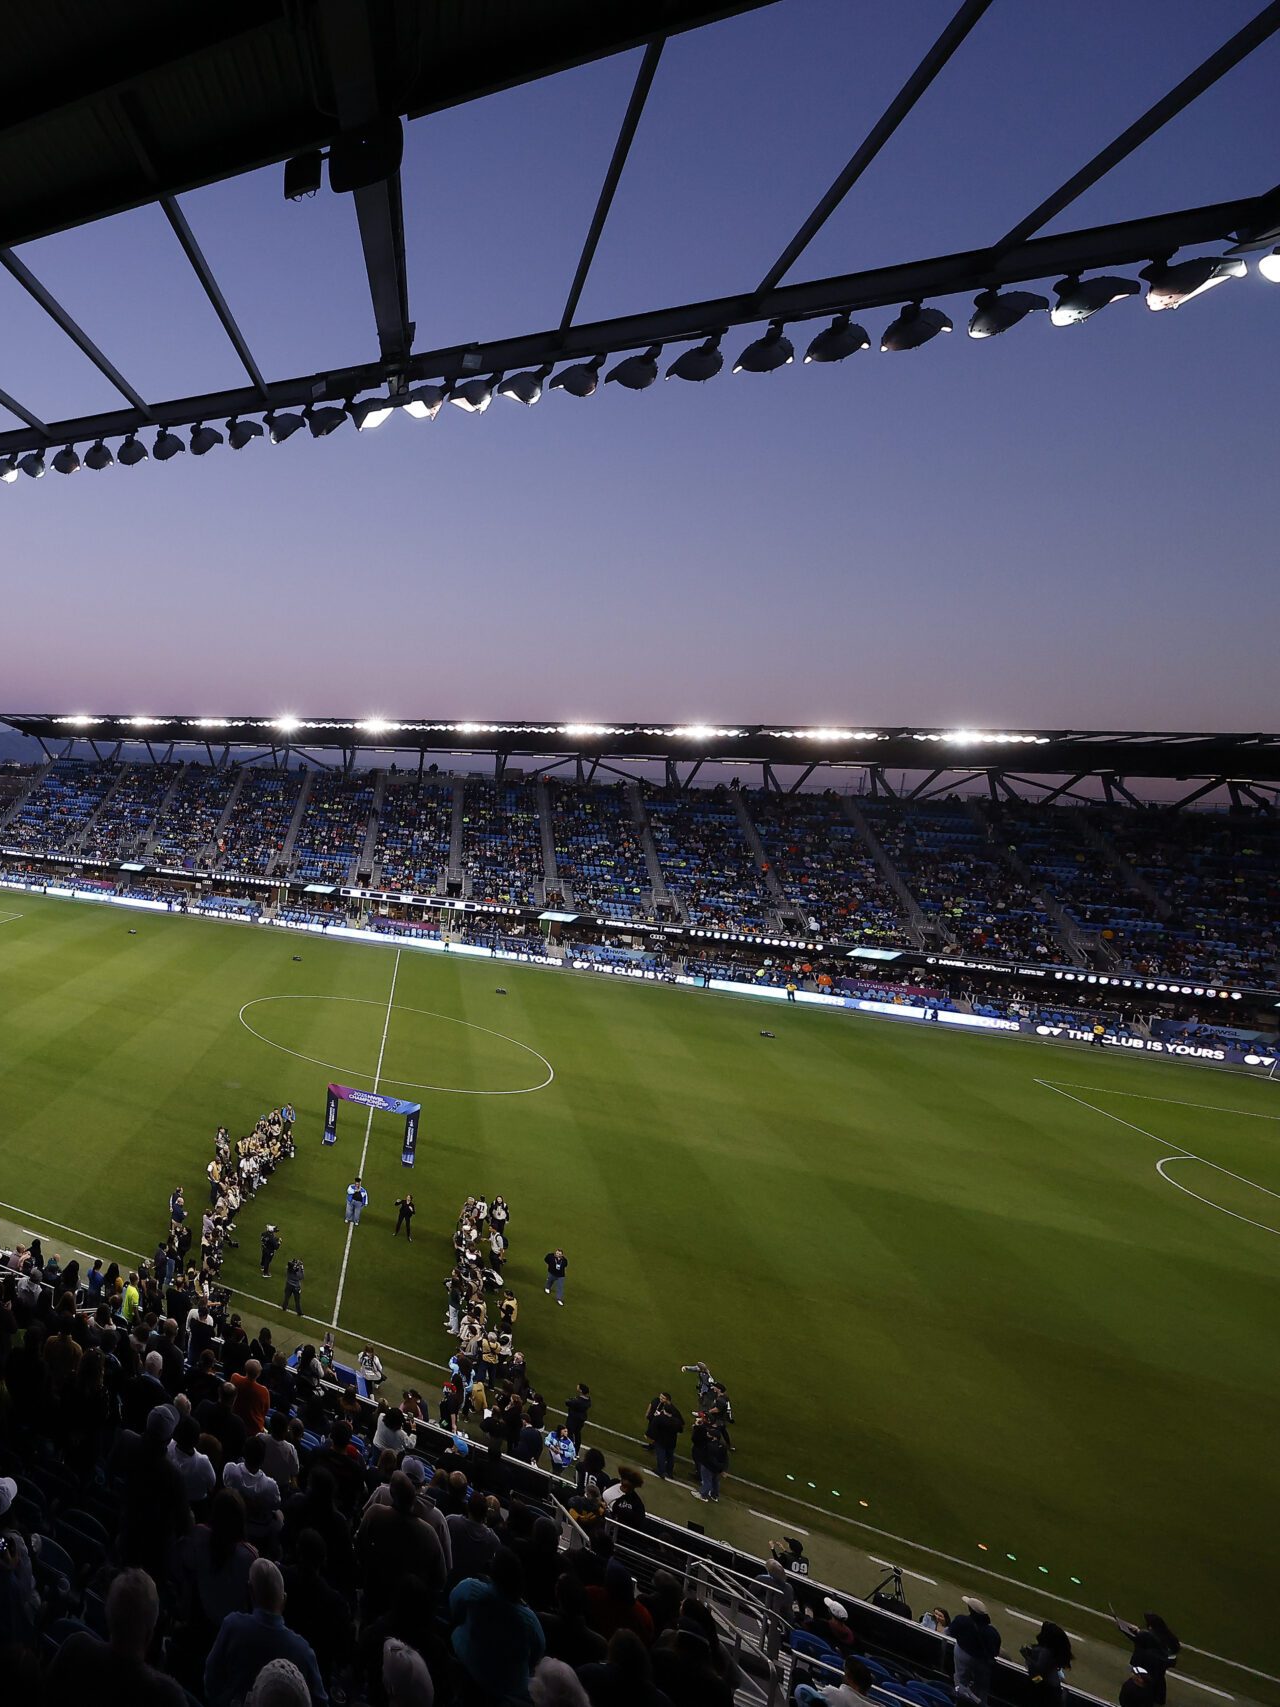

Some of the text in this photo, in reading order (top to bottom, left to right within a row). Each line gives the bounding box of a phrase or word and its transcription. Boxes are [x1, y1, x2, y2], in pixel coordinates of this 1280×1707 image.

[187, 906, 200, 915] THE
[201, 908, 219, 917] LUB
[227, 912, 251, 921] YOURS
[272, 918, 308, 930] THE CLUB
[519, 954, 528, 962] IS
[529, 954, 563, 966] YOURS
[593, 963, 613, 974] THE
[613, 966, 643, 978] CLUB
[644, 970, 655, 979] IS
[1039, 1006, 1090, 1017] CHAMPIONSHIP
[973, 1016, 1020, 1031] OURS
[1209, 1027, 1241, 1037] NWSL
[1102, 1034, 1144, 1049] CLUB
[1146, 1040, 1163, 1051] IS
[1165, 1043, 1225, 1060] YOURS
[348, 1094, 389, 1107] CHAMPIONSHIP
[791, 1561, 808, 1574] 09
